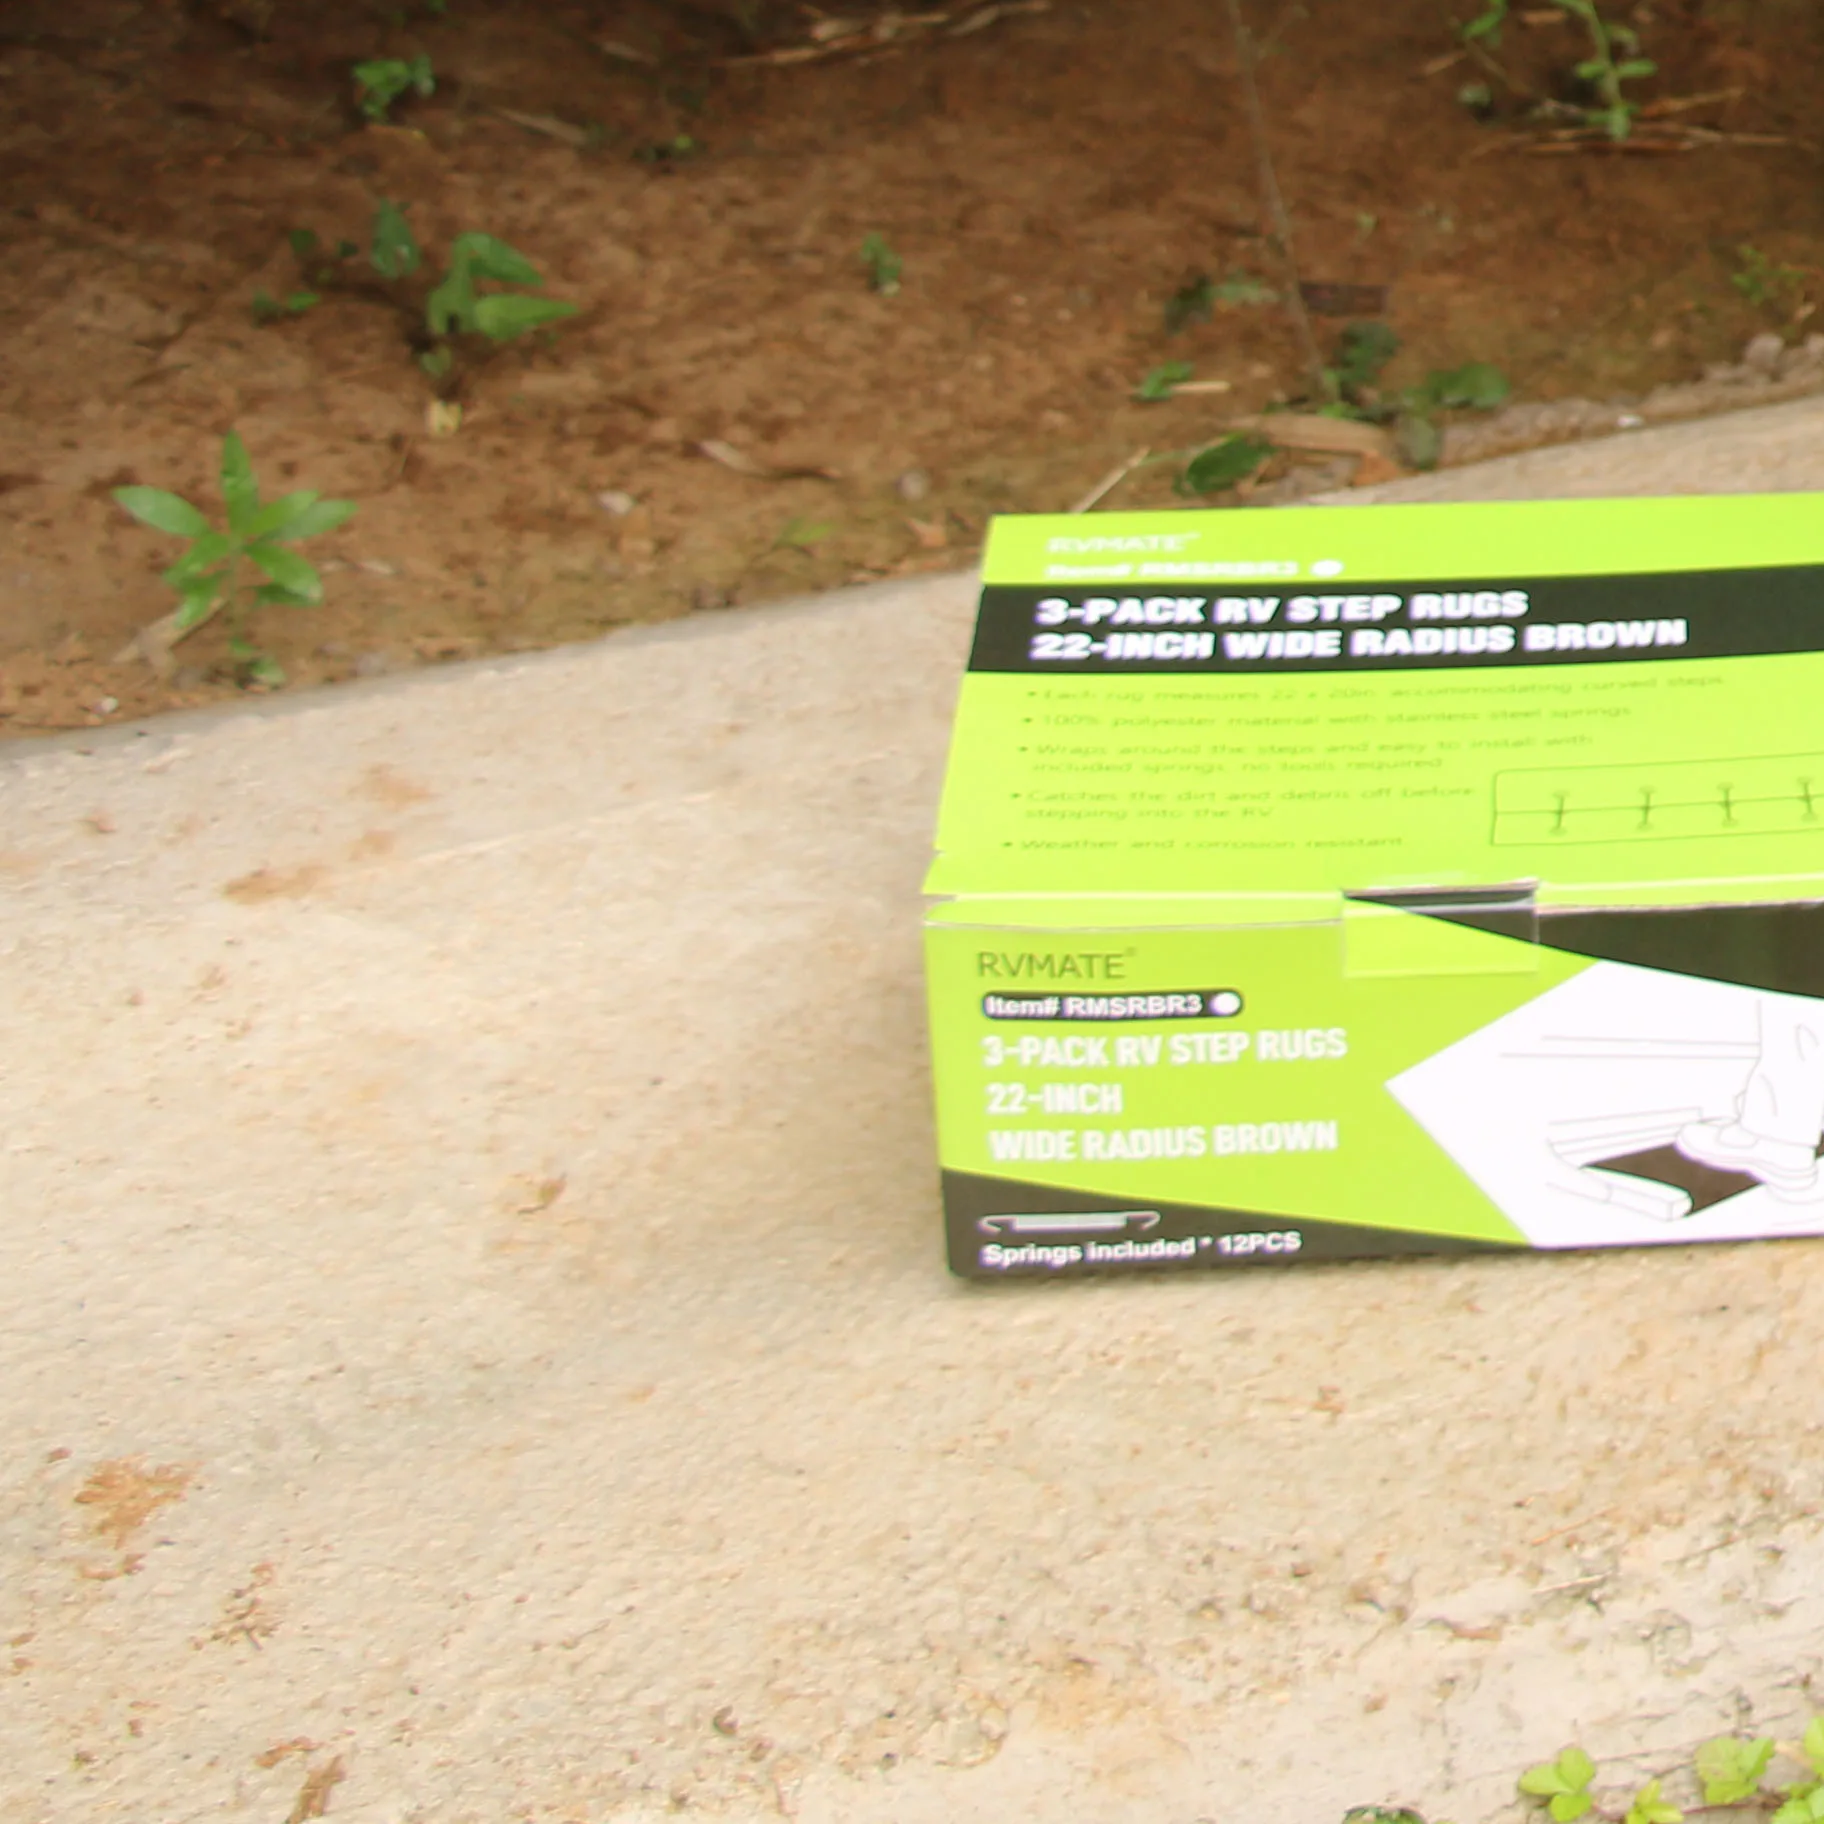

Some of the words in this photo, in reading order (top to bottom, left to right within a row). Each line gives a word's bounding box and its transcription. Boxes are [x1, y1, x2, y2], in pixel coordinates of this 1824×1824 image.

[1036, 596, 1207, 625] 3-PACK
[1214, 596, 1280, 624] RV
[1286, 593, 1402, 623] STEP
[1410, 590, 1530, 620] RUGS
[1030, 631, 1215, 660] 22-INCH
[1223, 629, 1342, 659] WIDE
[1351, 625, 1516, 656] RADIUS
[1523, 618, 1688, 651] BROWN
[1581, 677, 1657, 691] curved
[1665, 674, 1724, 689] steps
[1043, 714, 1101, 727] 100%
[1111, 715, 1216, 729] polyester
[1228, 713, 1319, 727] material
[1328, 712, 1378, 725] with
[1386, 708, 1480, 723] stainless
[1490, 707, 1543, 721] steel
[1550, 705, 1632, 721] springs
[1036, 742, 1107, 757] Wraps
[1118, 742, 1201, 755] around
[1208, 742, 1246, 755] the
[1257, 742, 1315, 756] steps
[1324, 740, 1370, 754] and
[1437, 739, 1461, 752] to
[1469, 736, 1537, 751] install
[1545, 734, 1594, 747] with
[1031, 760, 1134, 773] included
[1241, 761, 1271, 773] no
[1280, 759, 1336, 772] tools
[1346, 756, 1443, 772] required
[1027, 789, 1118, 802] Catches
[1130, 789, 1166, 802] the
[1176, 789, 1217, 802] dirt
[1227, 789, 1270, 802] and
[1280, 788, 1350, 801] debris
[1360, 786, 1392, 800] off
[1401, 784, 1476, 798] before
[1024, 807, 1129, 822] stepping
[1135, 807, 1183, 819] into
[1193, 807, 1231, 819] the
[1240, 806, 1274, 819] RV
[1020, 838, 1119, 850] Weather
[1130, 838, 1175, 850] and
[1184, 838, 1296, 850] corrosion
[1305, 836, 1404, 849] resistant
[977, 951, 1127, 979] RVMATE
[985, 995, 1060, 1017] Item#
[1063, 993, 1204, 1018] RMSRBR3
[981, 1034, 1109, 1068] 3-PACK
[1115, 1034, 1163, 1067] RV
[1168, 1031, 1250, 1064] STEP
[1256, 1027, 1349, 1062] RUGS
[985, 1081, 1124, 1116] 22-INCH
[989, 1129, 1077, 1162] WIDE
[1081, 1125, 1207, 1161] RADIUS
[1212, 1120, 1340, 1156] BROWN
[981, 1242, 1083, 1270] Springs
[1085, 1235, 1197, 1263] included
[1218, 1229, 1303, 1256] 12PCS
